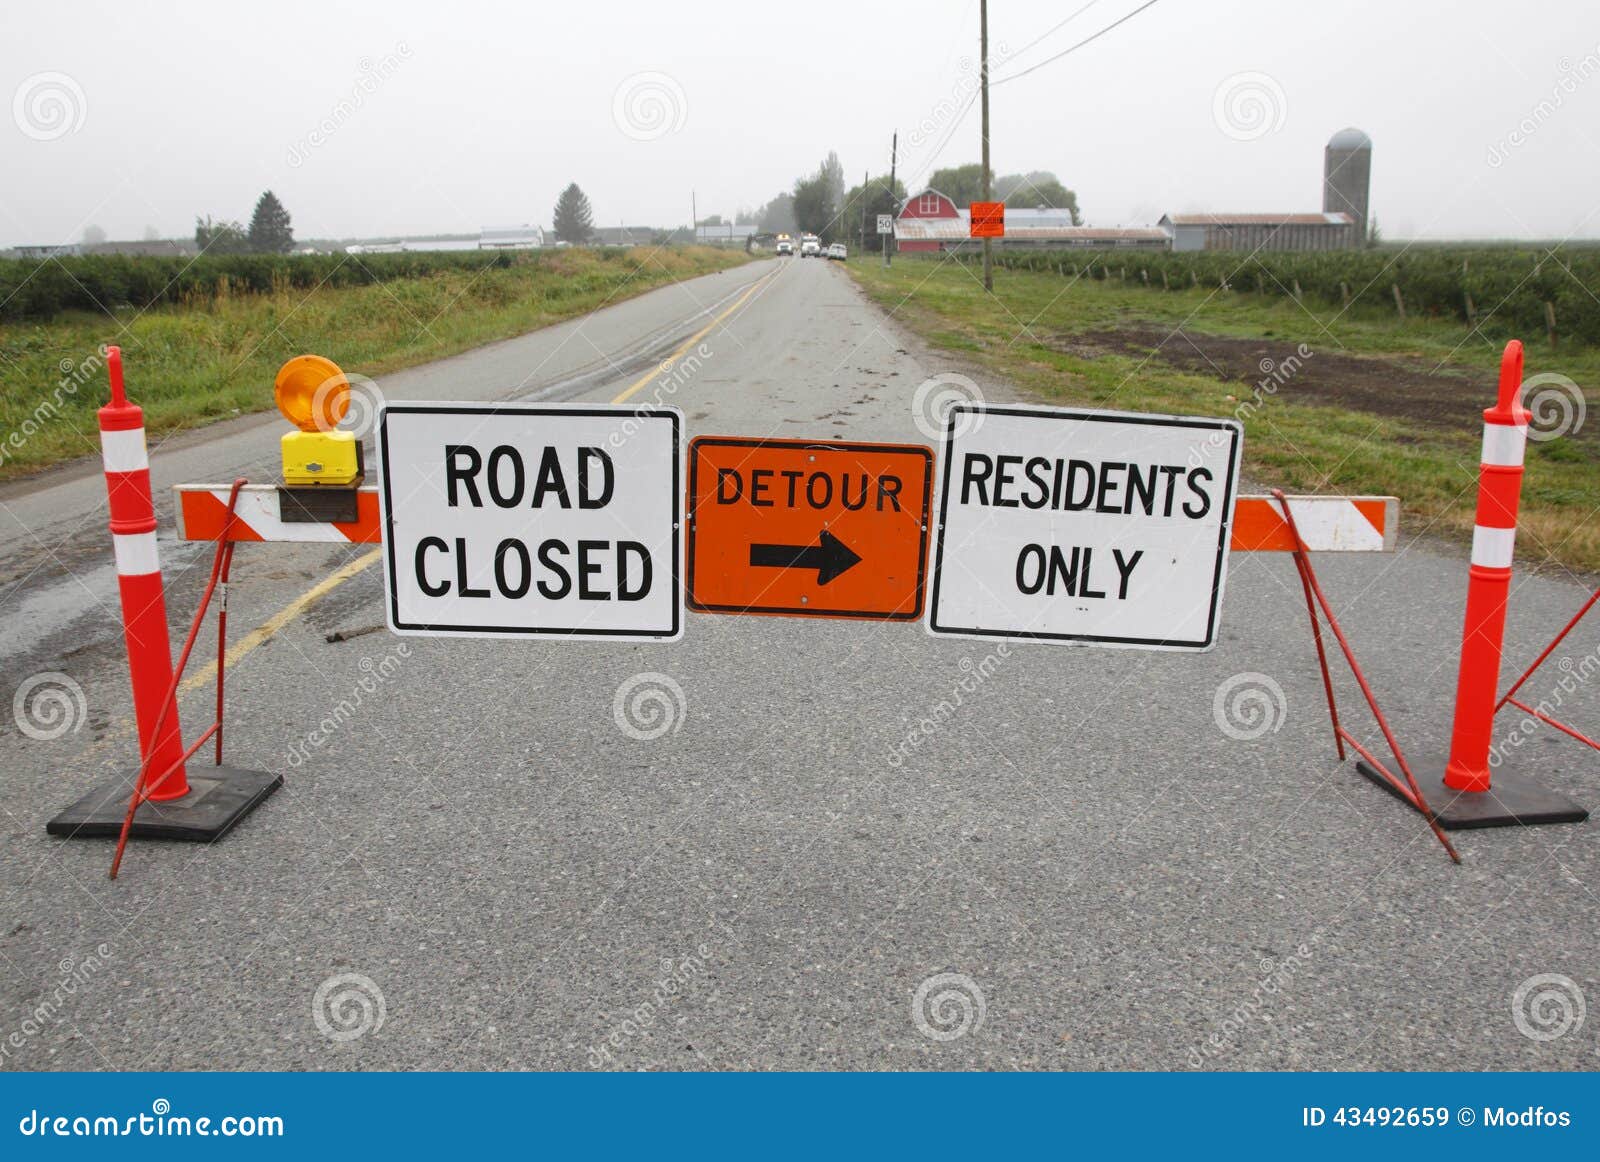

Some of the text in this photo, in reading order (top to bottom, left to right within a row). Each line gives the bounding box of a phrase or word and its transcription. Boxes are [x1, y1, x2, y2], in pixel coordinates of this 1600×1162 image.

[445, 444, 615, 509] ROAD
[716, 467, 903, 512] DETOUR
[961, 452, 1213, 519] RESIDENTS
[415, 536, 653, 601] CLOSED
[1016, 543, 1144, 600] ONLY
